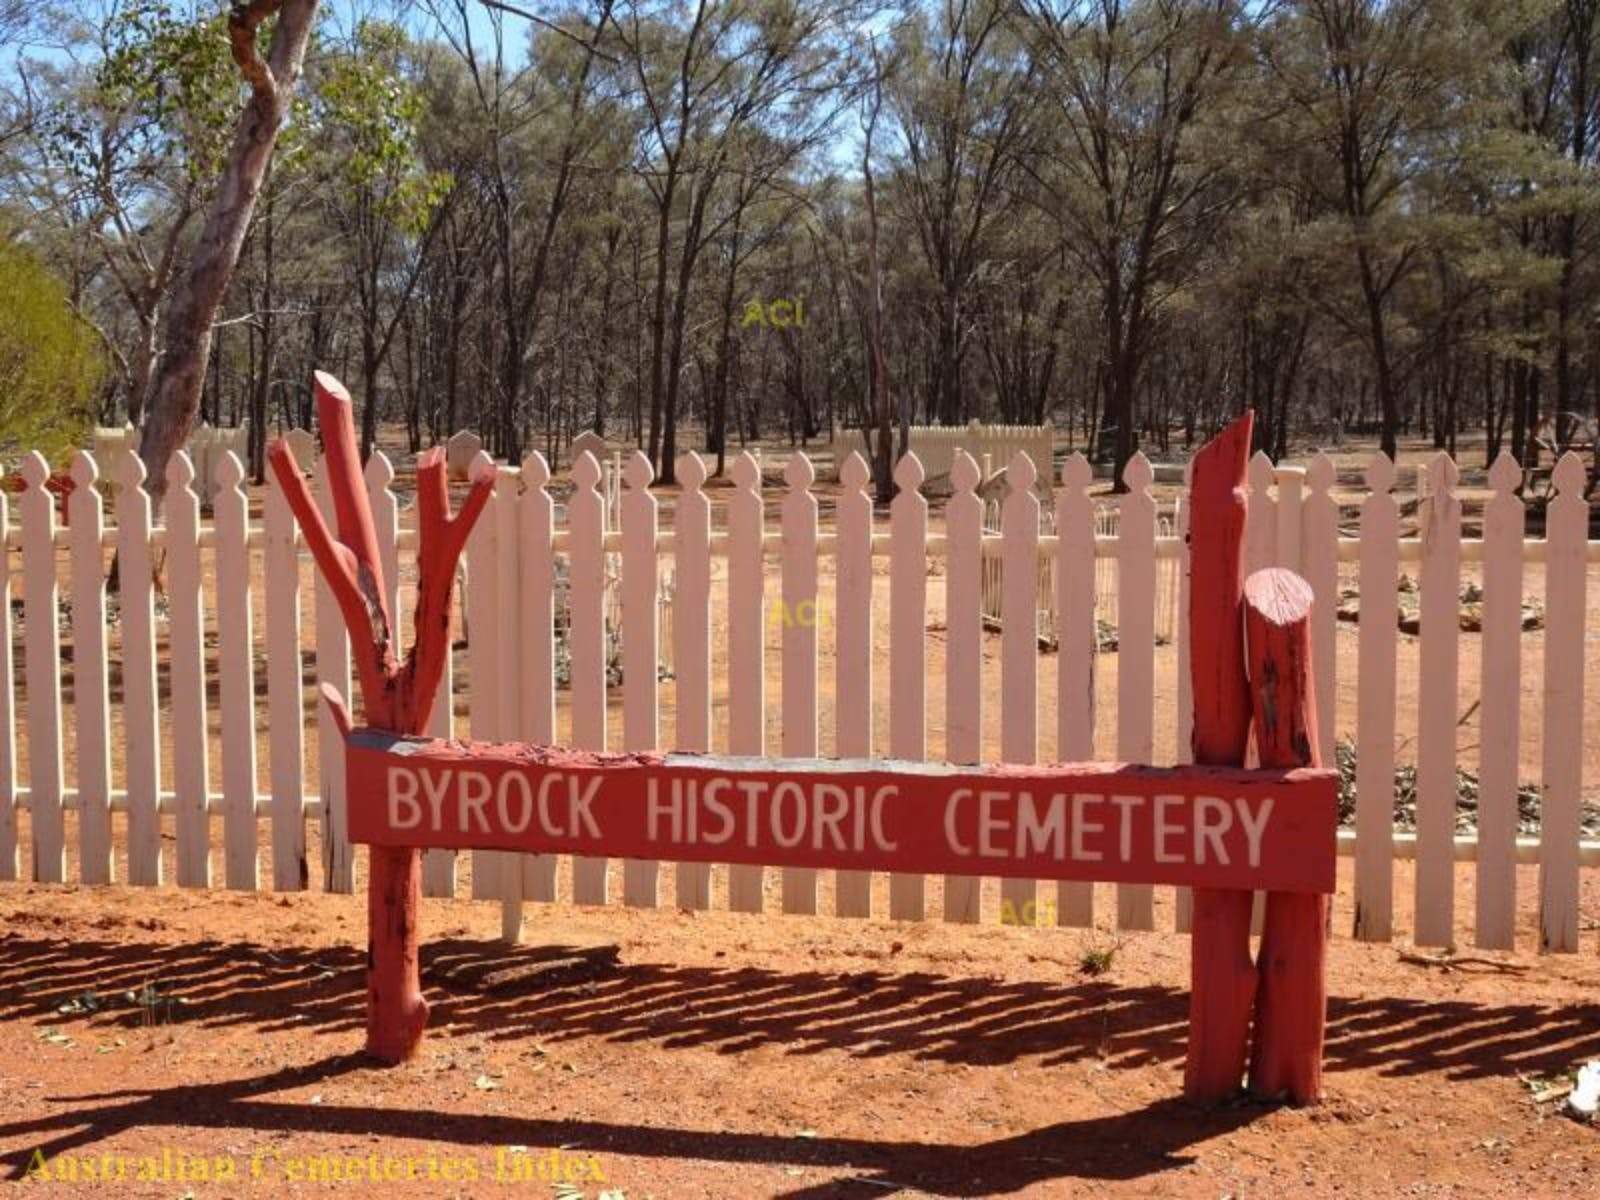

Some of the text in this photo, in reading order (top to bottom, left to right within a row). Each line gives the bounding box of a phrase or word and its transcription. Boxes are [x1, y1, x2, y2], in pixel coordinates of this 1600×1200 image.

[386, 766, 1275, 868] BYROCK HISTORIC CEMETERY
